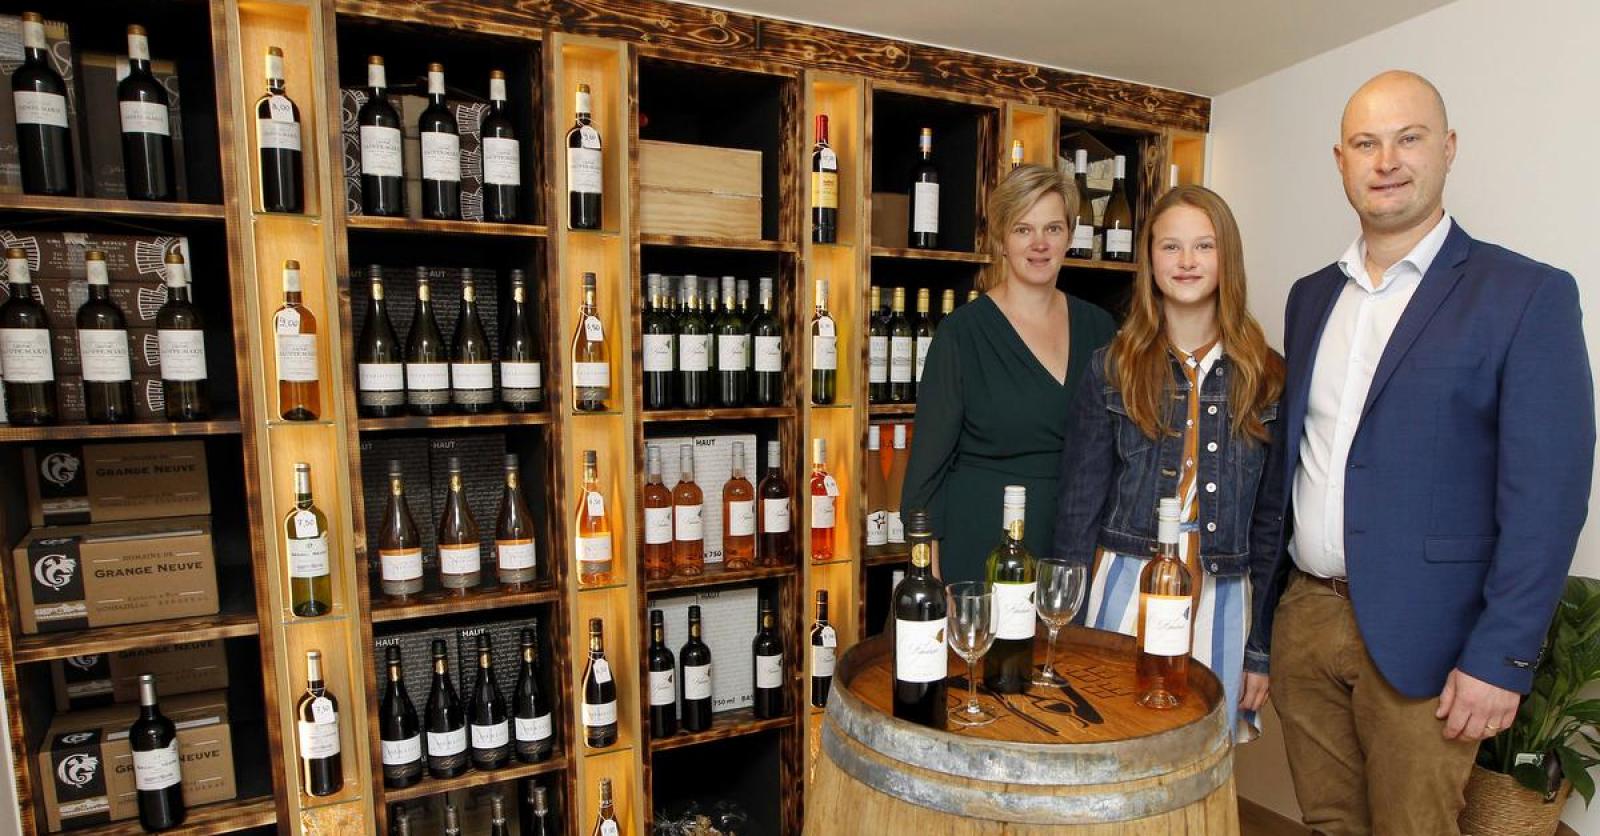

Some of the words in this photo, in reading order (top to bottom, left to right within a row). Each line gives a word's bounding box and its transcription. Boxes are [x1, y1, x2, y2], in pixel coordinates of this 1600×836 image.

[429, 270, 446, 278] AUT
[153, 463, 197, 474] NEUVE
[94, 566, 153, 579] GRANGE
[157, 560, 204, 573] NEUVE
[462, 628, 485, 637] HAUT
[375, 638, 399, 647] HAUT
